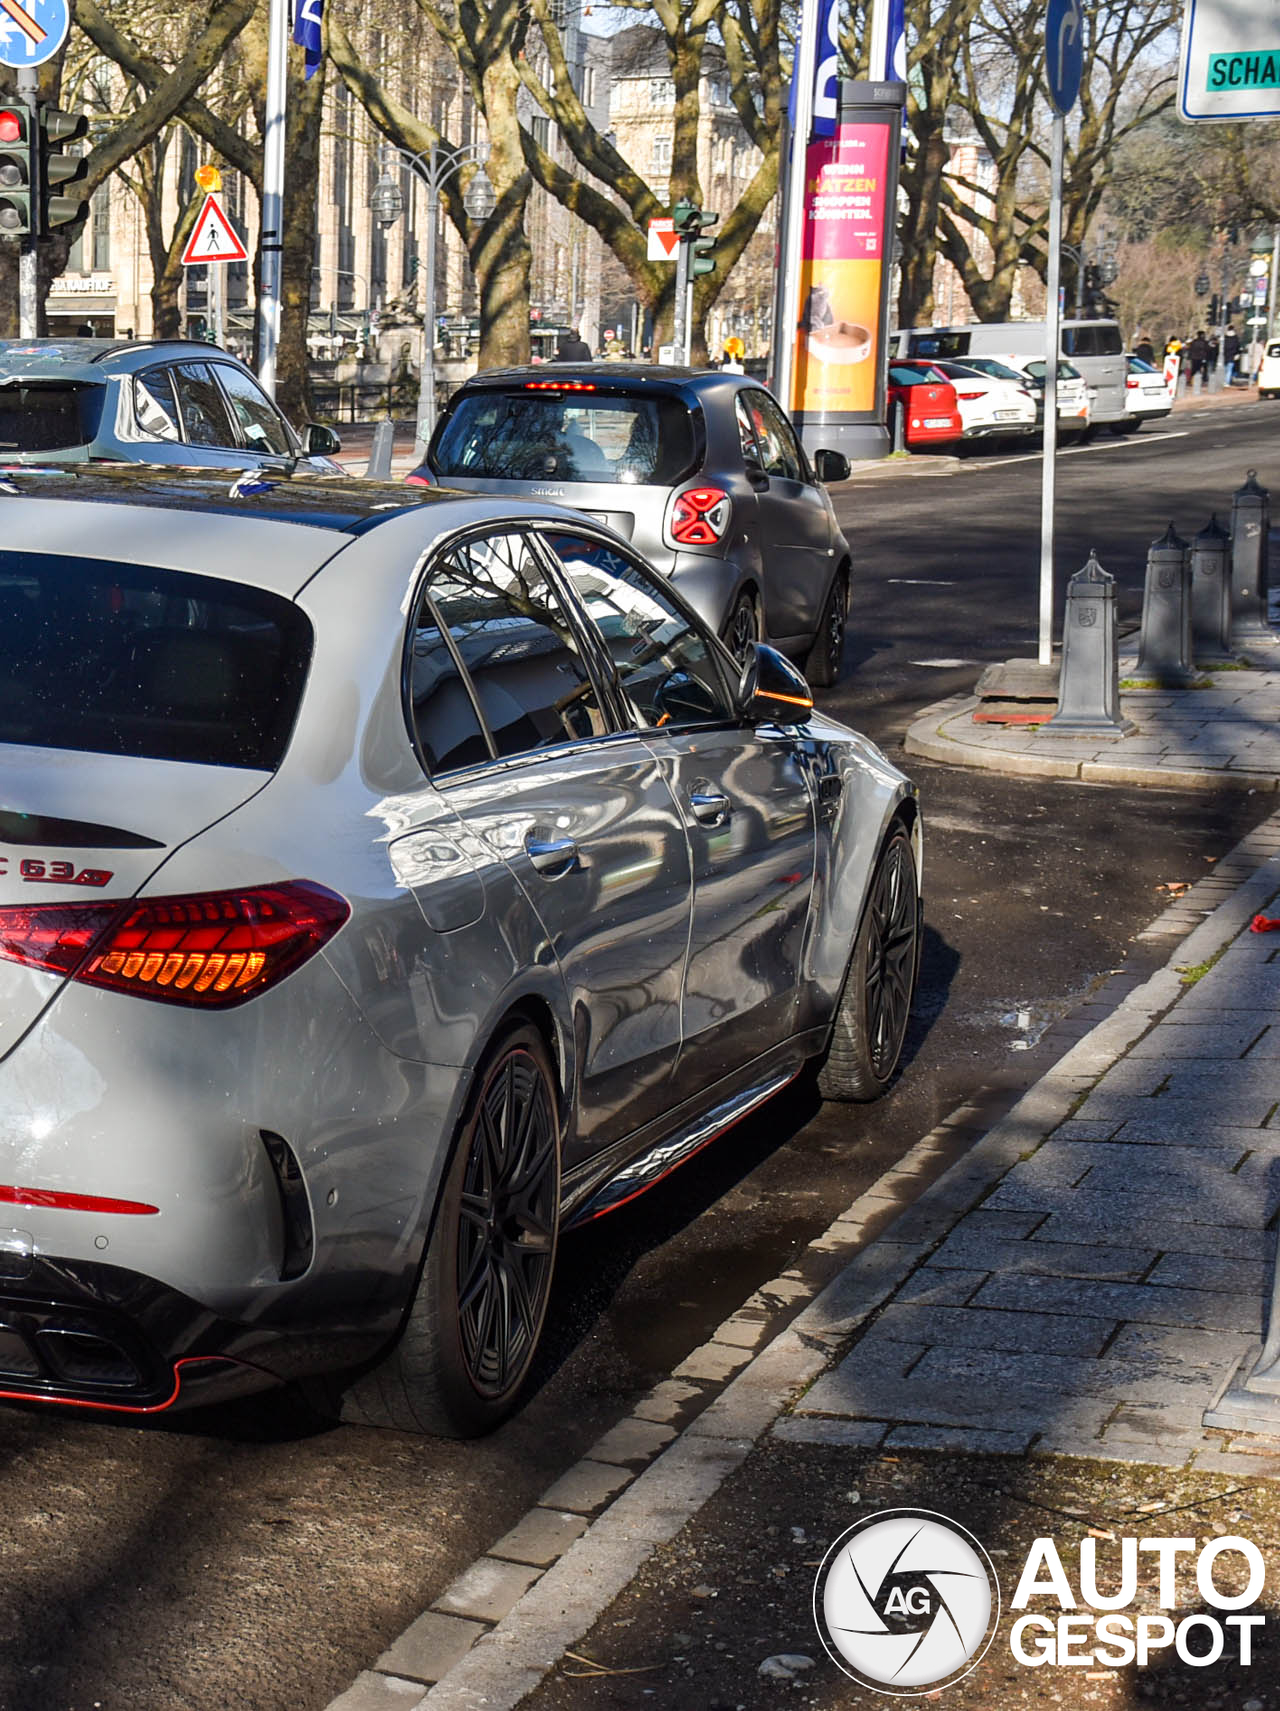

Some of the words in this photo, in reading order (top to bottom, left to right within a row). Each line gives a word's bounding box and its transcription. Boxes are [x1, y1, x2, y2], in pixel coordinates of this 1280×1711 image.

[1212, 56, 1280, 86] SCHA
[823, 164, 864, 175] WENN
[808, 178, 876, 193] KATZEN
[812, 196, 871, 207] SHOPPEN
[531, 487, 566, 497] smart
